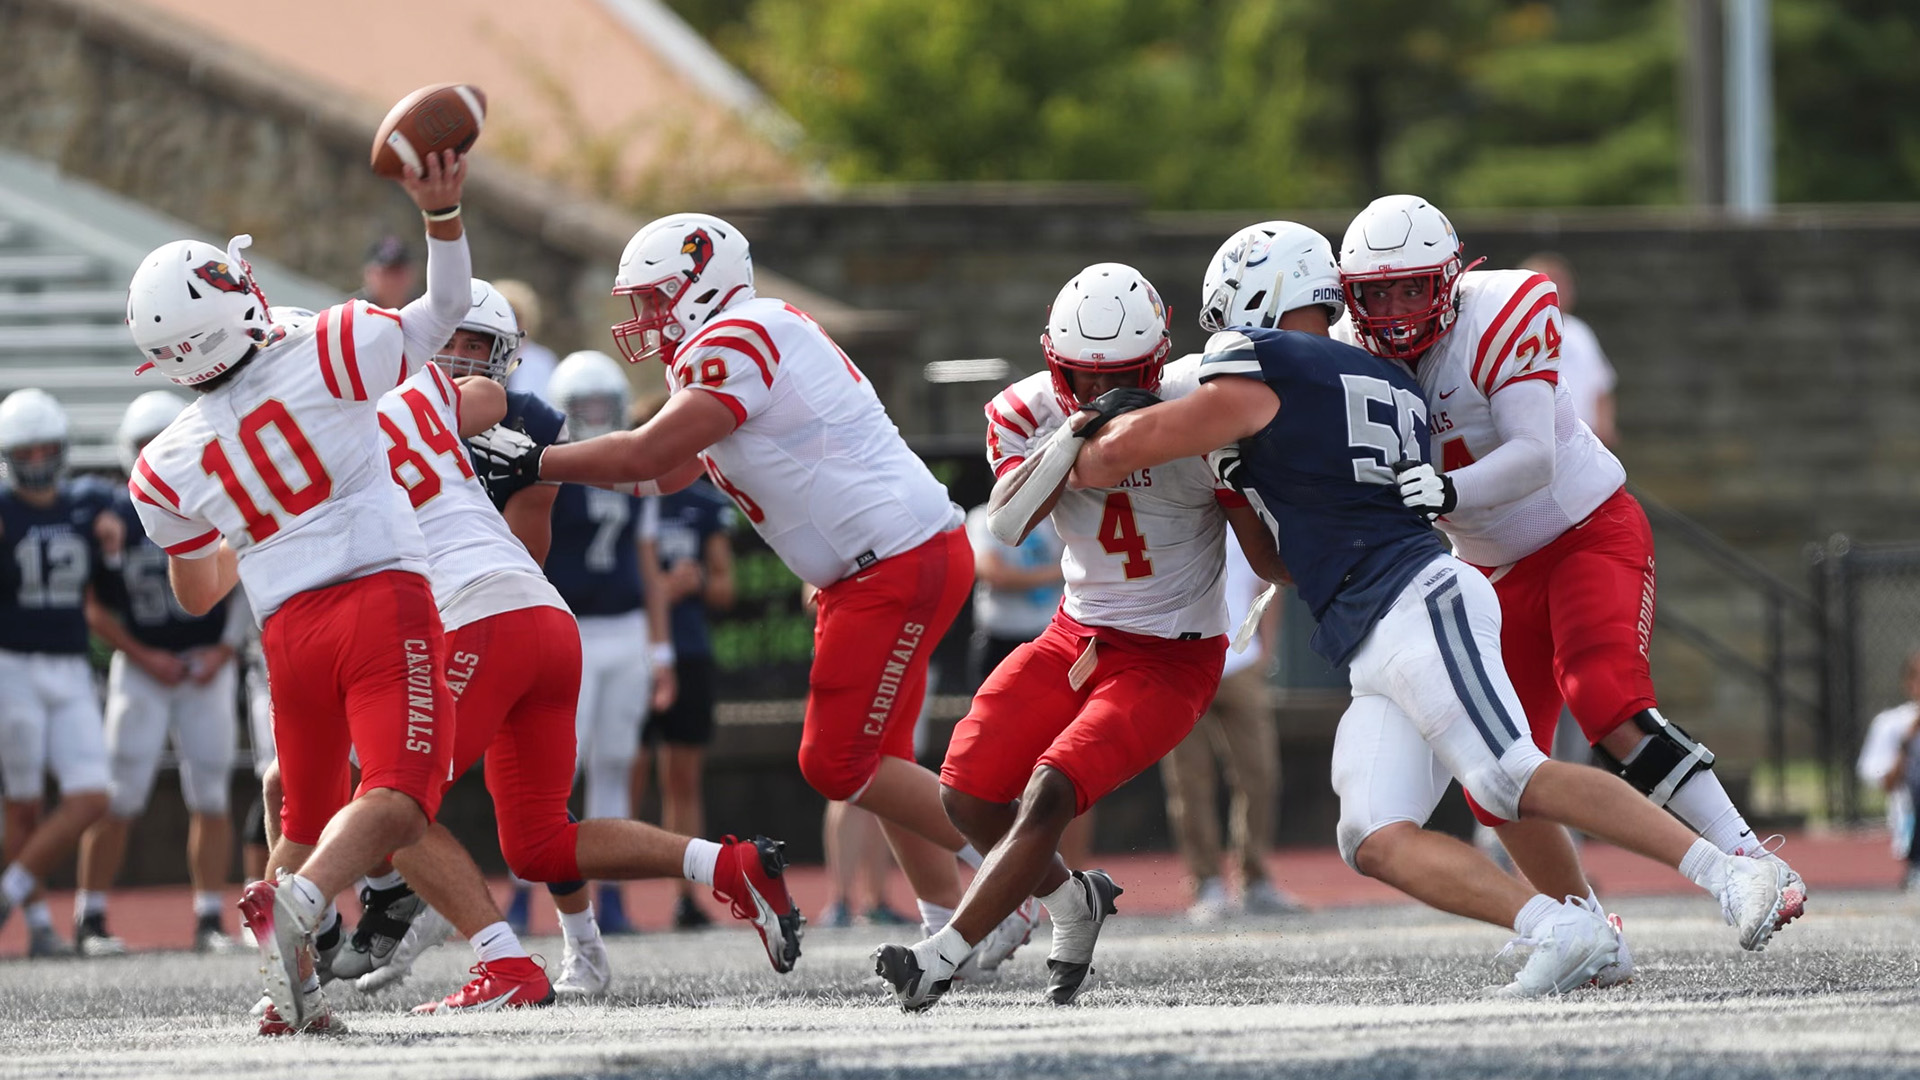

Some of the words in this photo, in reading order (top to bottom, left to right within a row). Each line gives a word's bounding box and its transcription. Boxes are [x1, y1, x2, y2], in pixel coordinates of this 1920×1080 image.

[1312, 287, 1345, 302] PIONE
[172, 362, 228, 385] Rddell
[177, 341, 193, 354] 10
[1515, 315, 1562, 374] 74
[200, 397, 334, 544] 10
[376, 387, 476, 510] 84
[585, 485, 630, 572] 7
[858, 552, 875, 566] 3XL
[1096, 491, 1155, 581] 4
[15, 534, 91, 609] 12
[404, 639, 434, 754] CARDINALS
[864, 622, 925, 736] CARDINALS
